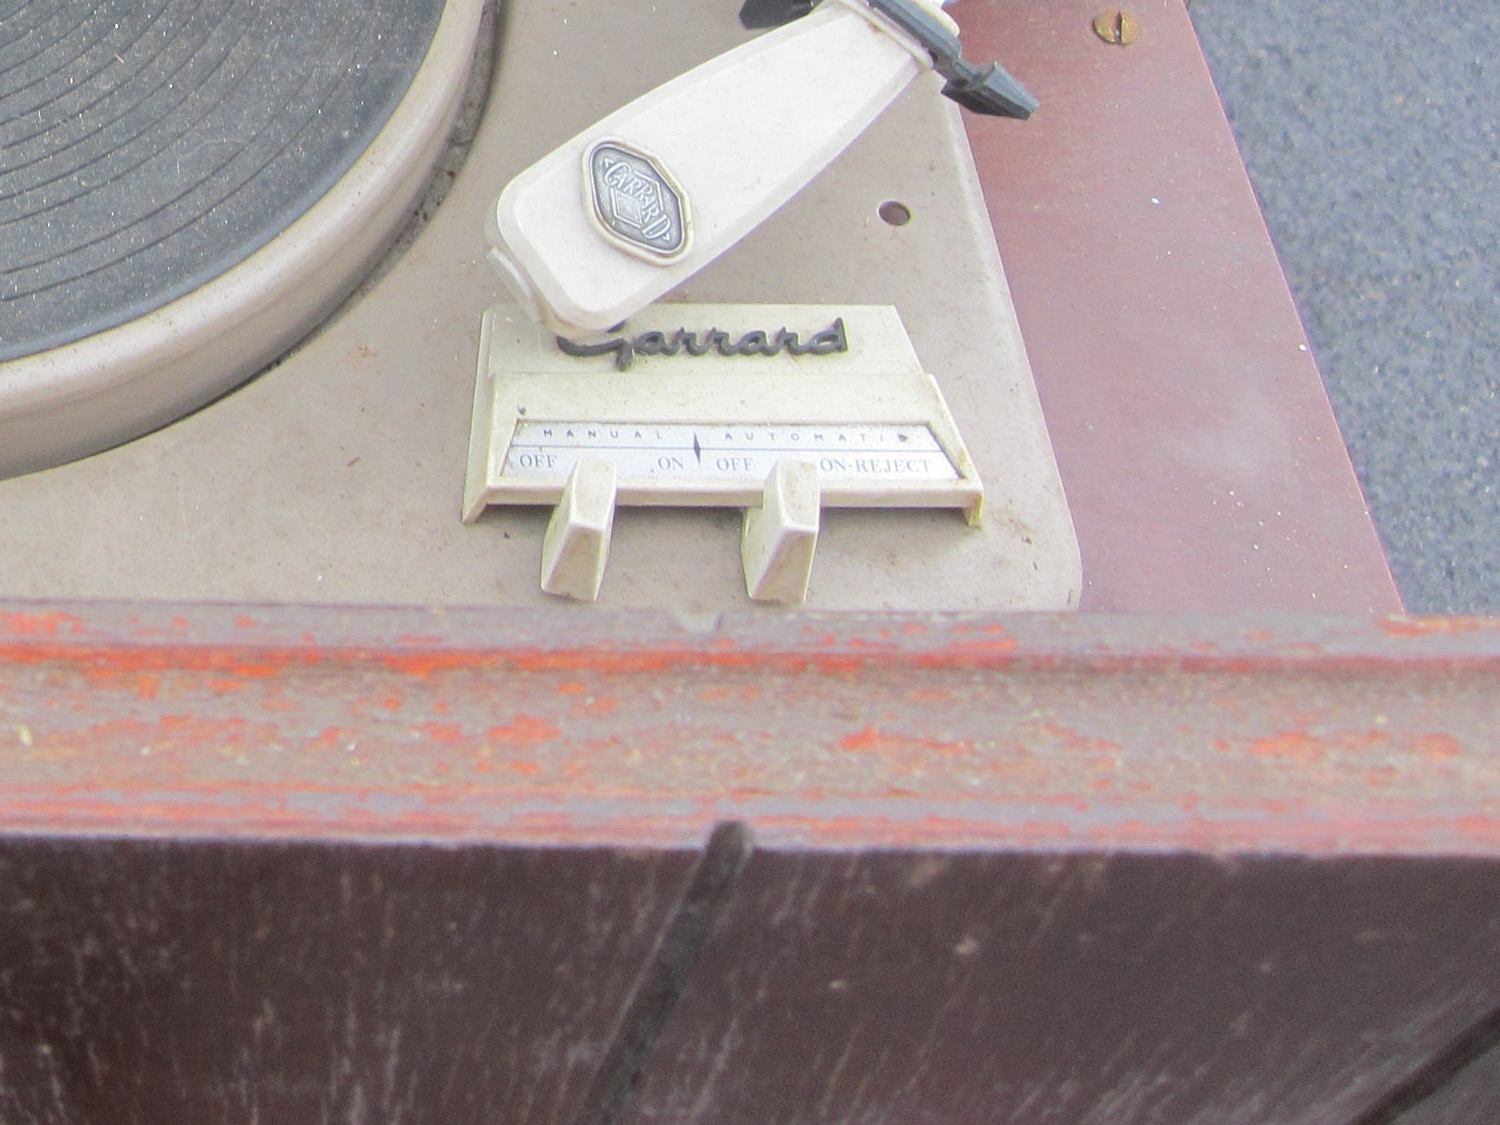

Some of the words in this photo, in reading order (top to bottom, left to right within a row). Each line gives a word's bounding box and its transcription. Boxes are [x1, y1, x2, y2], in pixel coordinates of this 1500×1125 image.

[543, 429, 663, 440] MANUAL
[519, 454, 558, 468] OFF
[657, 456, 684, 470] ON
[716, 457, 754, 472] OFF
[819, 457, 932, 473] ON-REJECT
